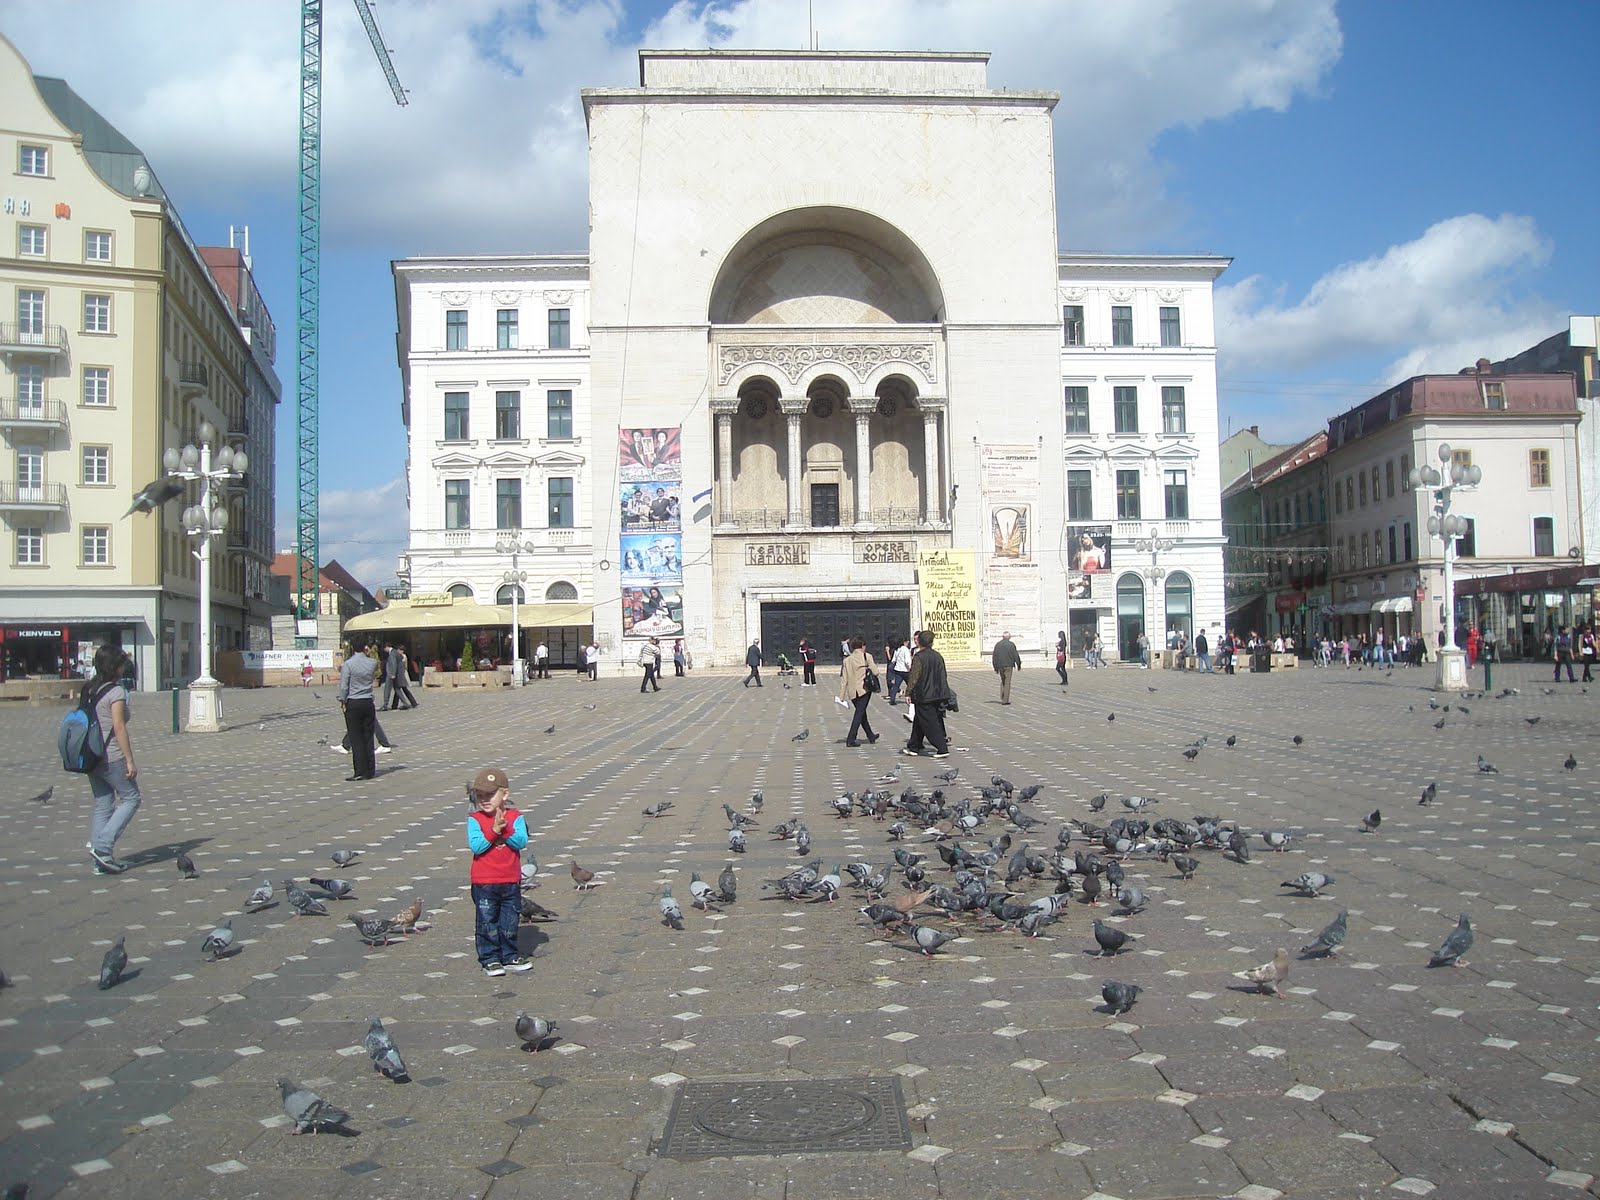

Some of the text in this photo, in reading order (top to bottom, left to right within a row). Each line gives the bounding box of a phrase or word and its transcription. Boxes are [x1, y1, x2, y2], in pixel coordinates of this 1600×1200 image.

[748, 544, 807, 555] TEATRUL
[865, 542, 904, 552] OPERA
[750, 554, 807, 565] NATIONAL
[935, 600, 959, 611] MAIA
[925, 610, 976, 622] MORGENSTERN
[928, 622, 956, 632] MIRCEA
[957, 621, 976, 631] RUSU
